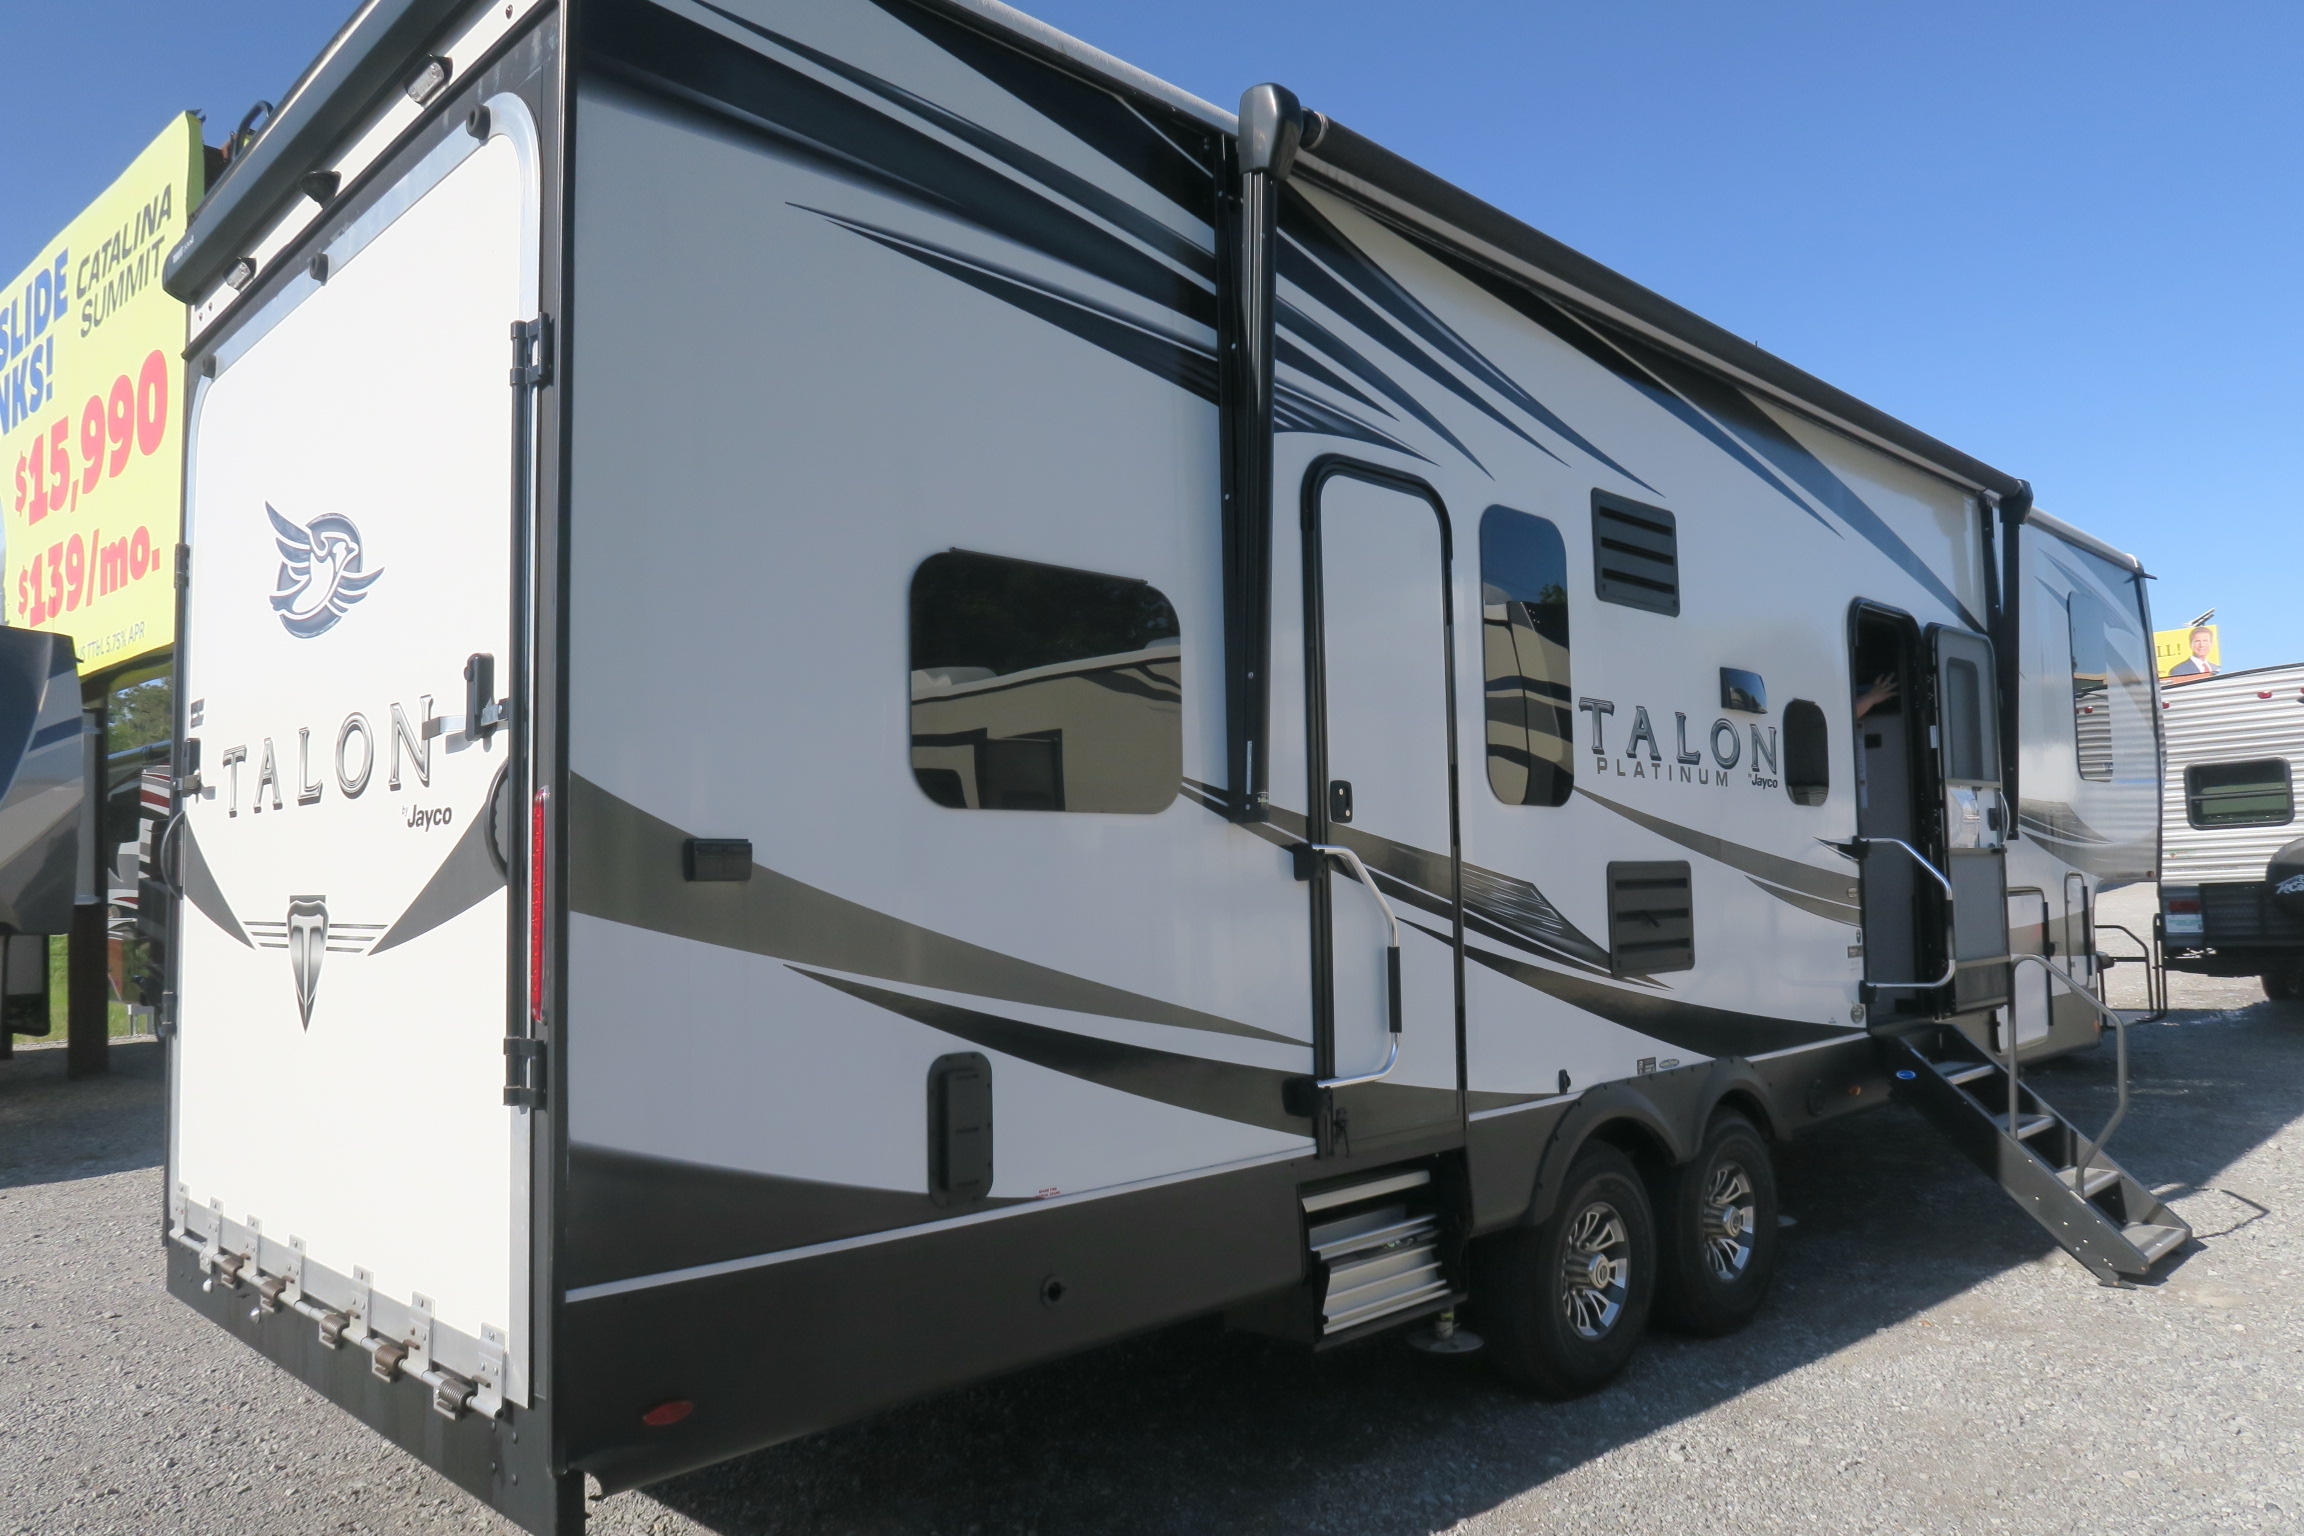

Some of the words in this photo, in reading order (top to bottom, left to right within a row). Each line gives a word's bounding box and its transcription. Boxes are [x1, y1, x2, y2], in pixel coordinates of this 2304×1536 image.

[76, 182, 172, 301] CATALINA
[80, 235, 166, 338] SUMMIT
[0, 247, 69, 372] SLIDE
[14, 349, 169, 527] $15,990
[18, 525, 161, 629] $139/mo.
[128, 621, 145, 645] APR
[222, 694, 433, 818] TALON
[1578, 696, 1777, 776] TALON
[1596, 757, 1729, 788] PLATINUM
[1751, 773, 1779, 790] Jayco
[407, 804, 453, 833] Jayco
